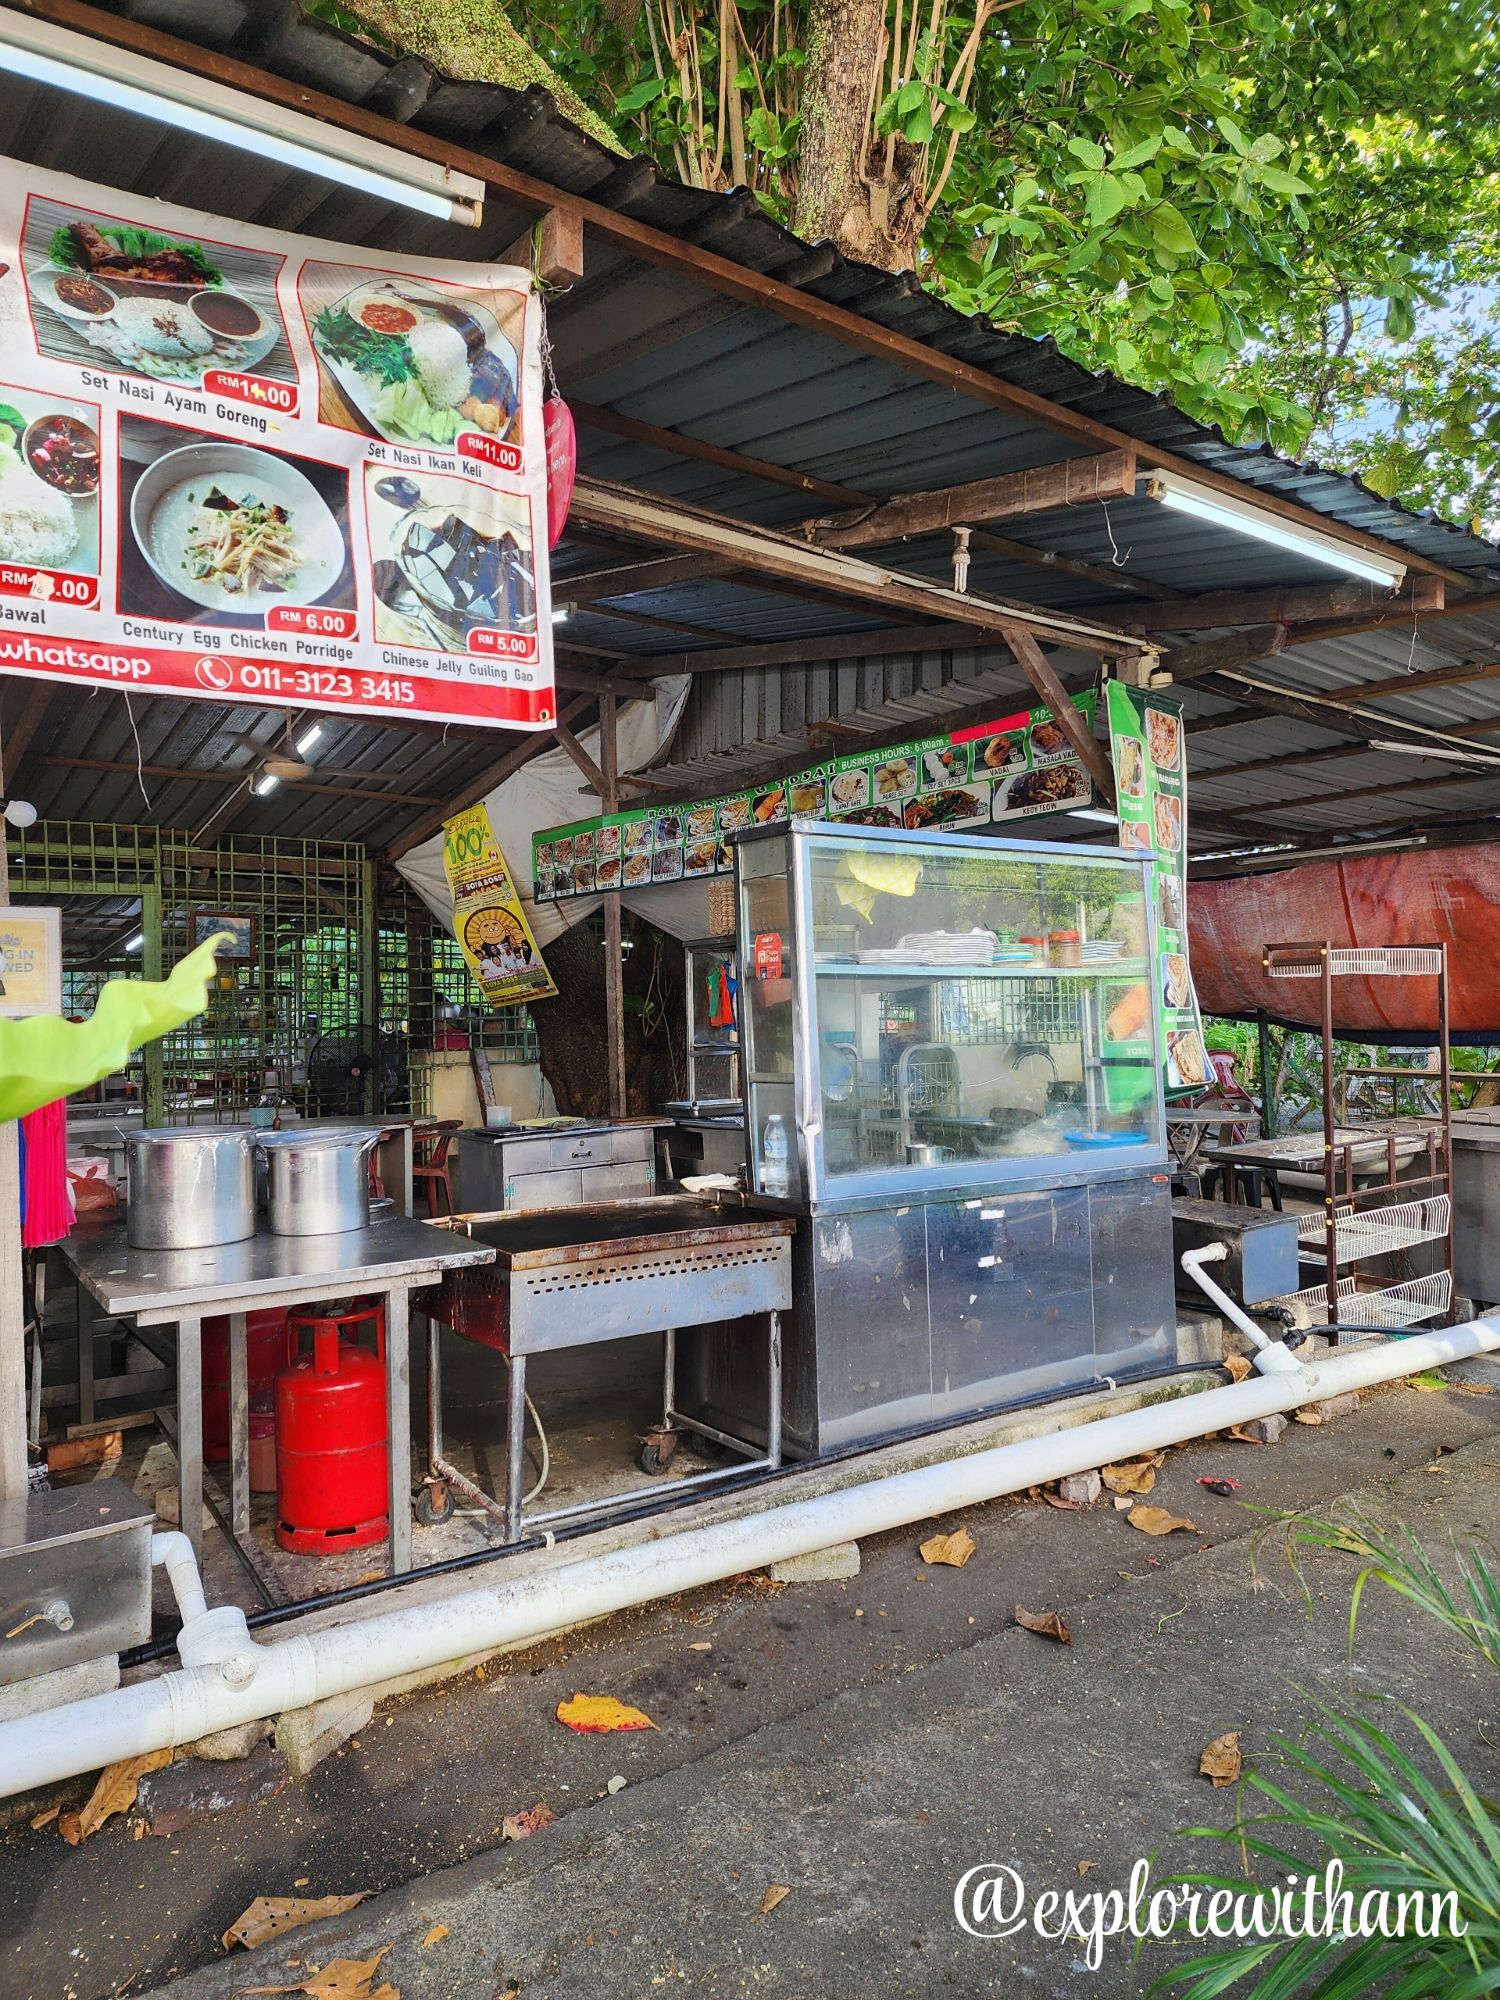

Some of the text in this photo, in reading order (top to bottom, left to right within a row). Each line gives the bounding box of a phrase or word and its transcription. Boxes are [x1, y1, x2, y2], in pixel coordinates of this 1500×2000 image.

[81, 371, 267, 433] Set Nasi Ayam Goreng
[368, 443, 482, 478] Set Nasi Ikan Keli
[467, 437, 517, 467] RM11.00
[280, 610, 345, 633] RM 6.00
[123, 622, 353, 662] Century Egg Chicken Porridge
[477, 634, 526, 653] RM 5.00
[382, 651, 534, 682] Chinese Jelly Guiling Gao
[240, 665, 353, 697] 011-3123
[360, 677, 415, 703] 3415
[841, 754, 880, 770] BUSINESS
[881, 745, 913, 761] HOURS:
[914, 738, 944, 753] 6:00am
[1037, 750, 1078, 766] MASALA VAD
[775, 763, 837, 789] TOSAI
[989, 766, 1010, 776] VADAI
[446, 824, 490, 864] 100%
